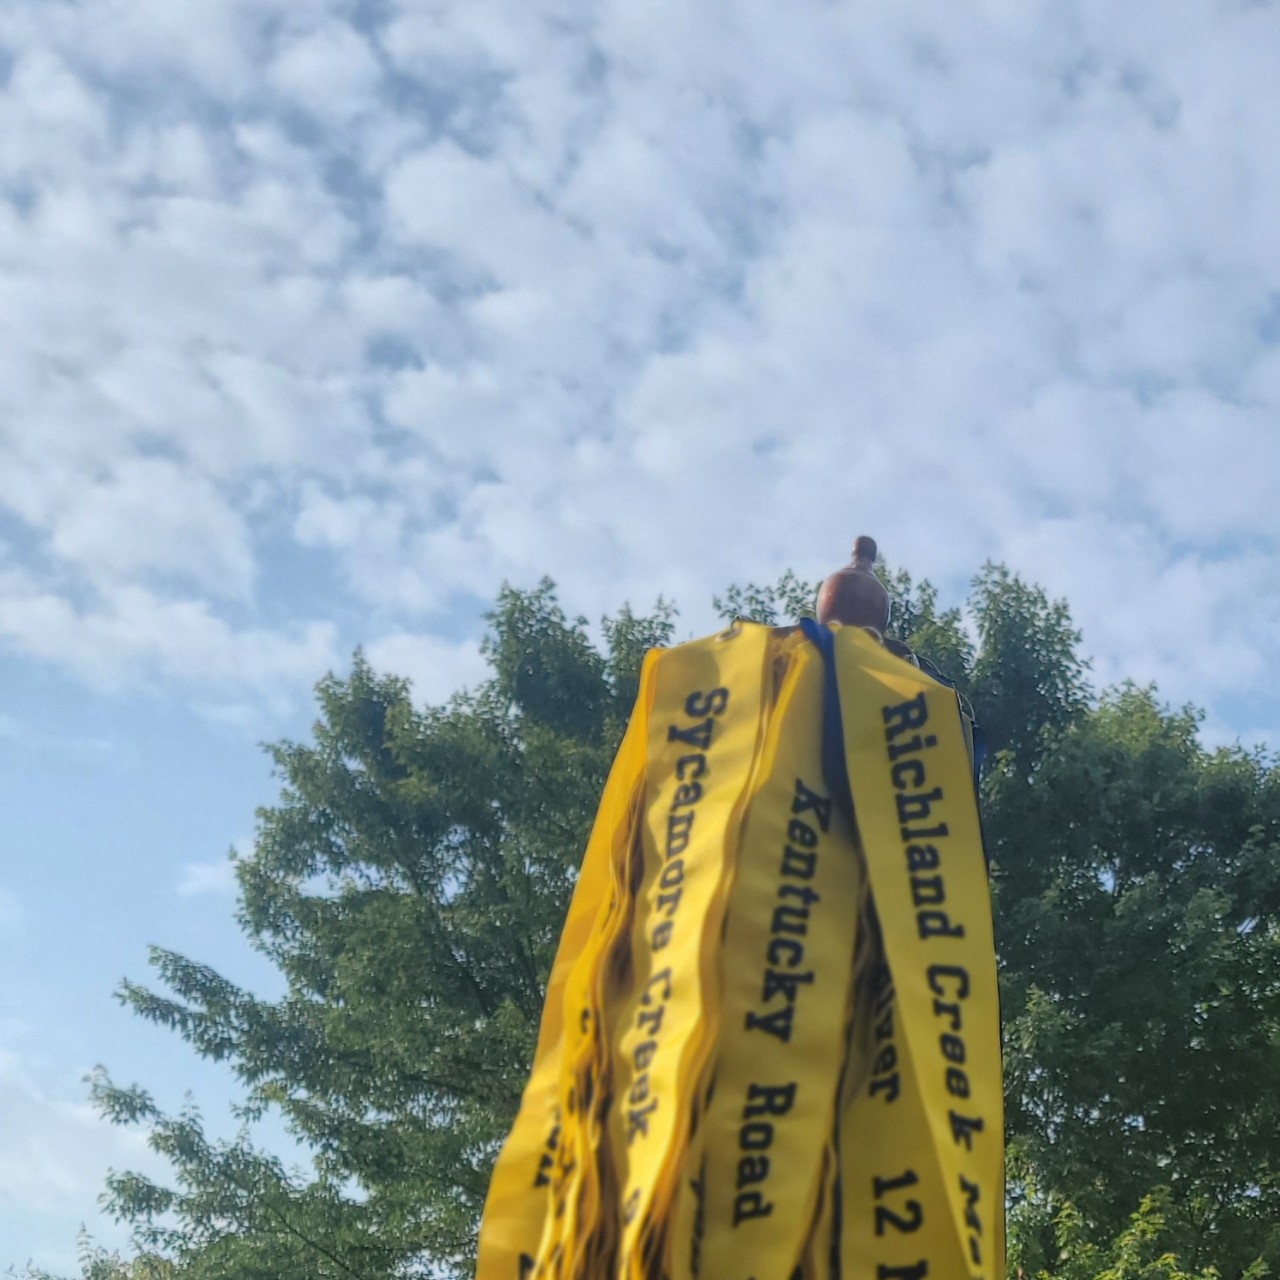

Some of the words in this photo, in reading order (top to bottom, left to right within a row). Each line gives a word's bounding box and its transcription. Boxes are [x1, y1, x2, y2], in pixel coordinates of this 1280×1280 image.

[649, 685, 731, 954] Sycamore
[744, 779, 835, 1043] Kentucky
[881, 692, 964, 941] Richland
[927, 964, 985, 1154] Creek
[625, 965, 673, 1145] Creek
[732, 1082, 798, 1228] Road
[872, 1168, 923, 1237] 12
